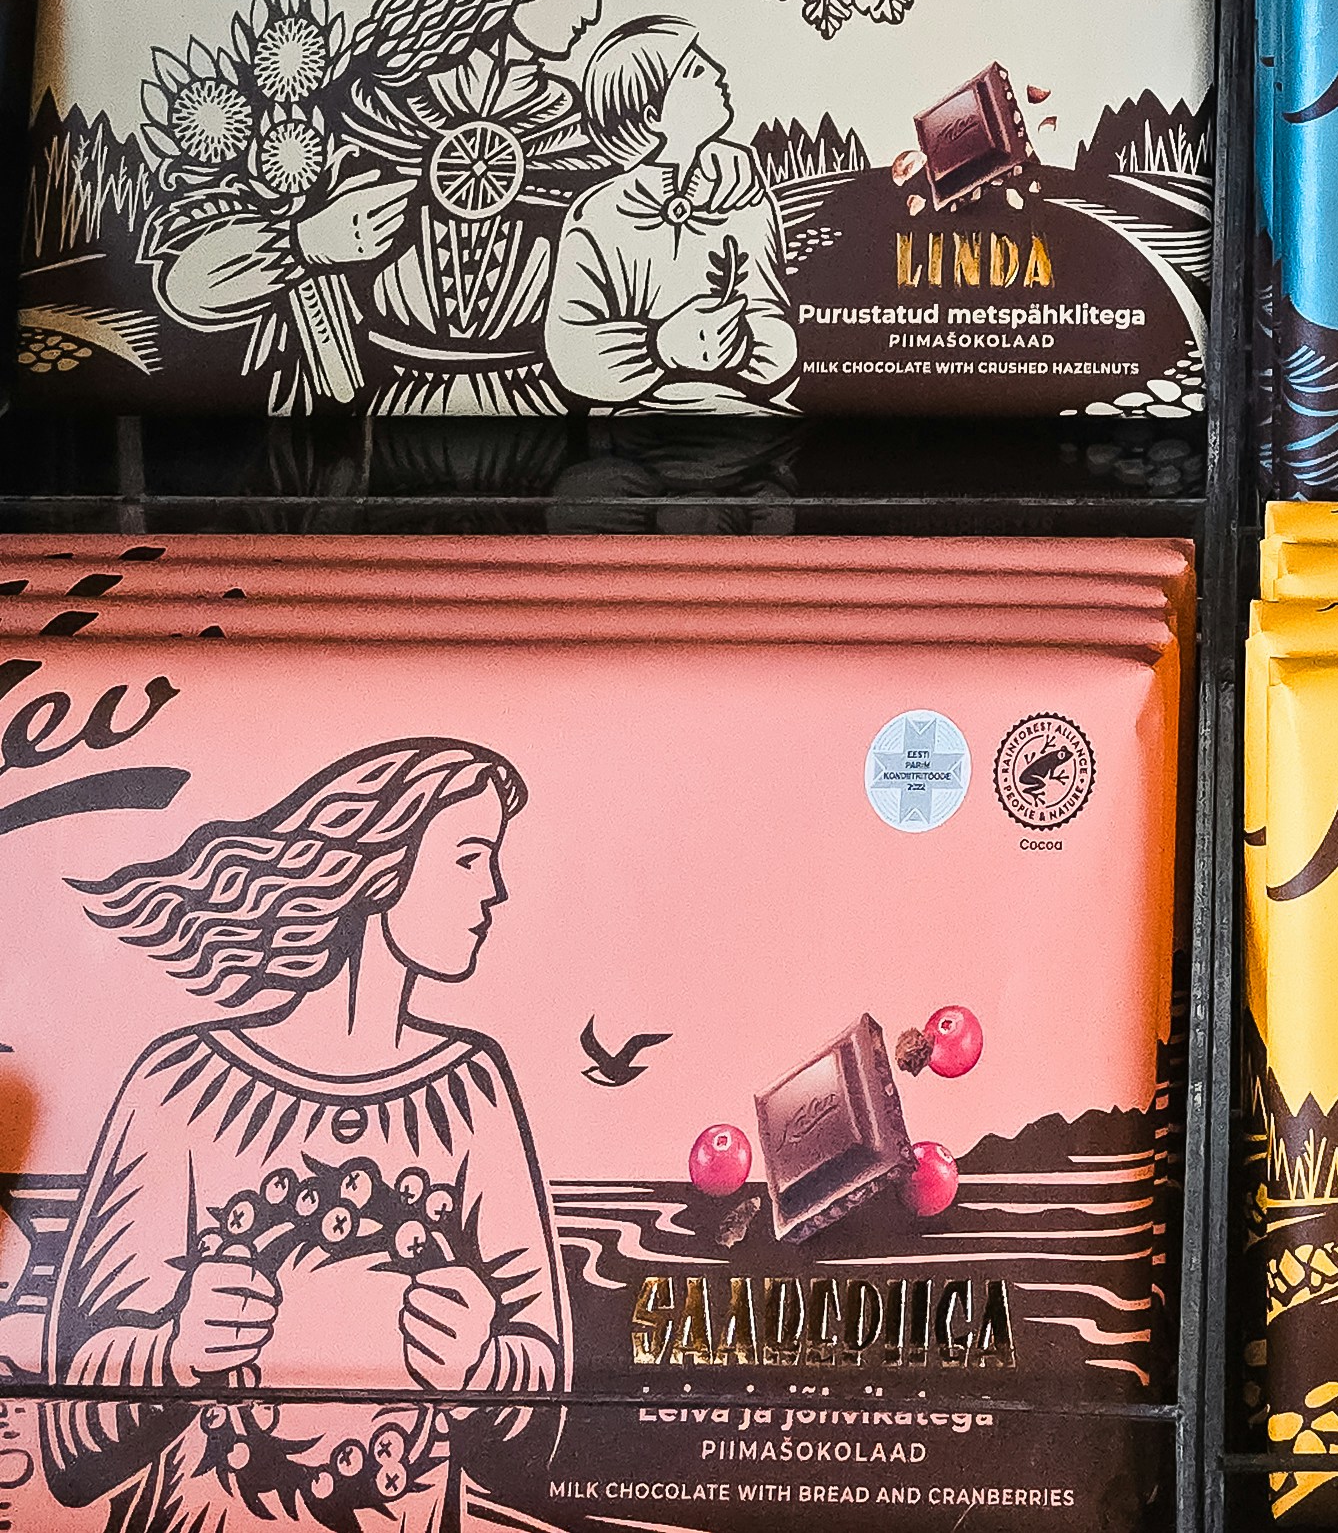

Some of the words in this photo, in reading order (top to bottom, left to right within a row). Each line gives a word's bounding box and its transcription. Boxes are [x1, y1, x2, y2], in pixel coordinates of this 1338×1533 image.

[896, 231, 1055, 288] LINDA
[799, 304, 939, 325] Purustatud
[949, 303, 1146, 329] metspähklitega
[889, 333, 1055, 349] PIIMAŠOKOLAAD
[803, 361, 838, 374] MILK
[842, 361, 931, 374] CHOCOLATE
[935, 362, 974, 374] WITH
[978, 362, 1048, 375] CRUSHED
[1053, 362, 1140, 375] HAZELNUTS
[1020, 838, 1063, 851] Cocoa
[701, 1436, 927, 1463] PIIMAŠOKOLAAD
[550, 1481, 598, 1501] MILK
[605, 1482, 730, 1501] CHOCOLATE
[738, 1485, 791, 1503] WITH
[799, 1486, 870, 1505] BREAD
[876, 1487, 922, 1505] AND
[928, 1488, 1075, 1507] CRANBERRIES
